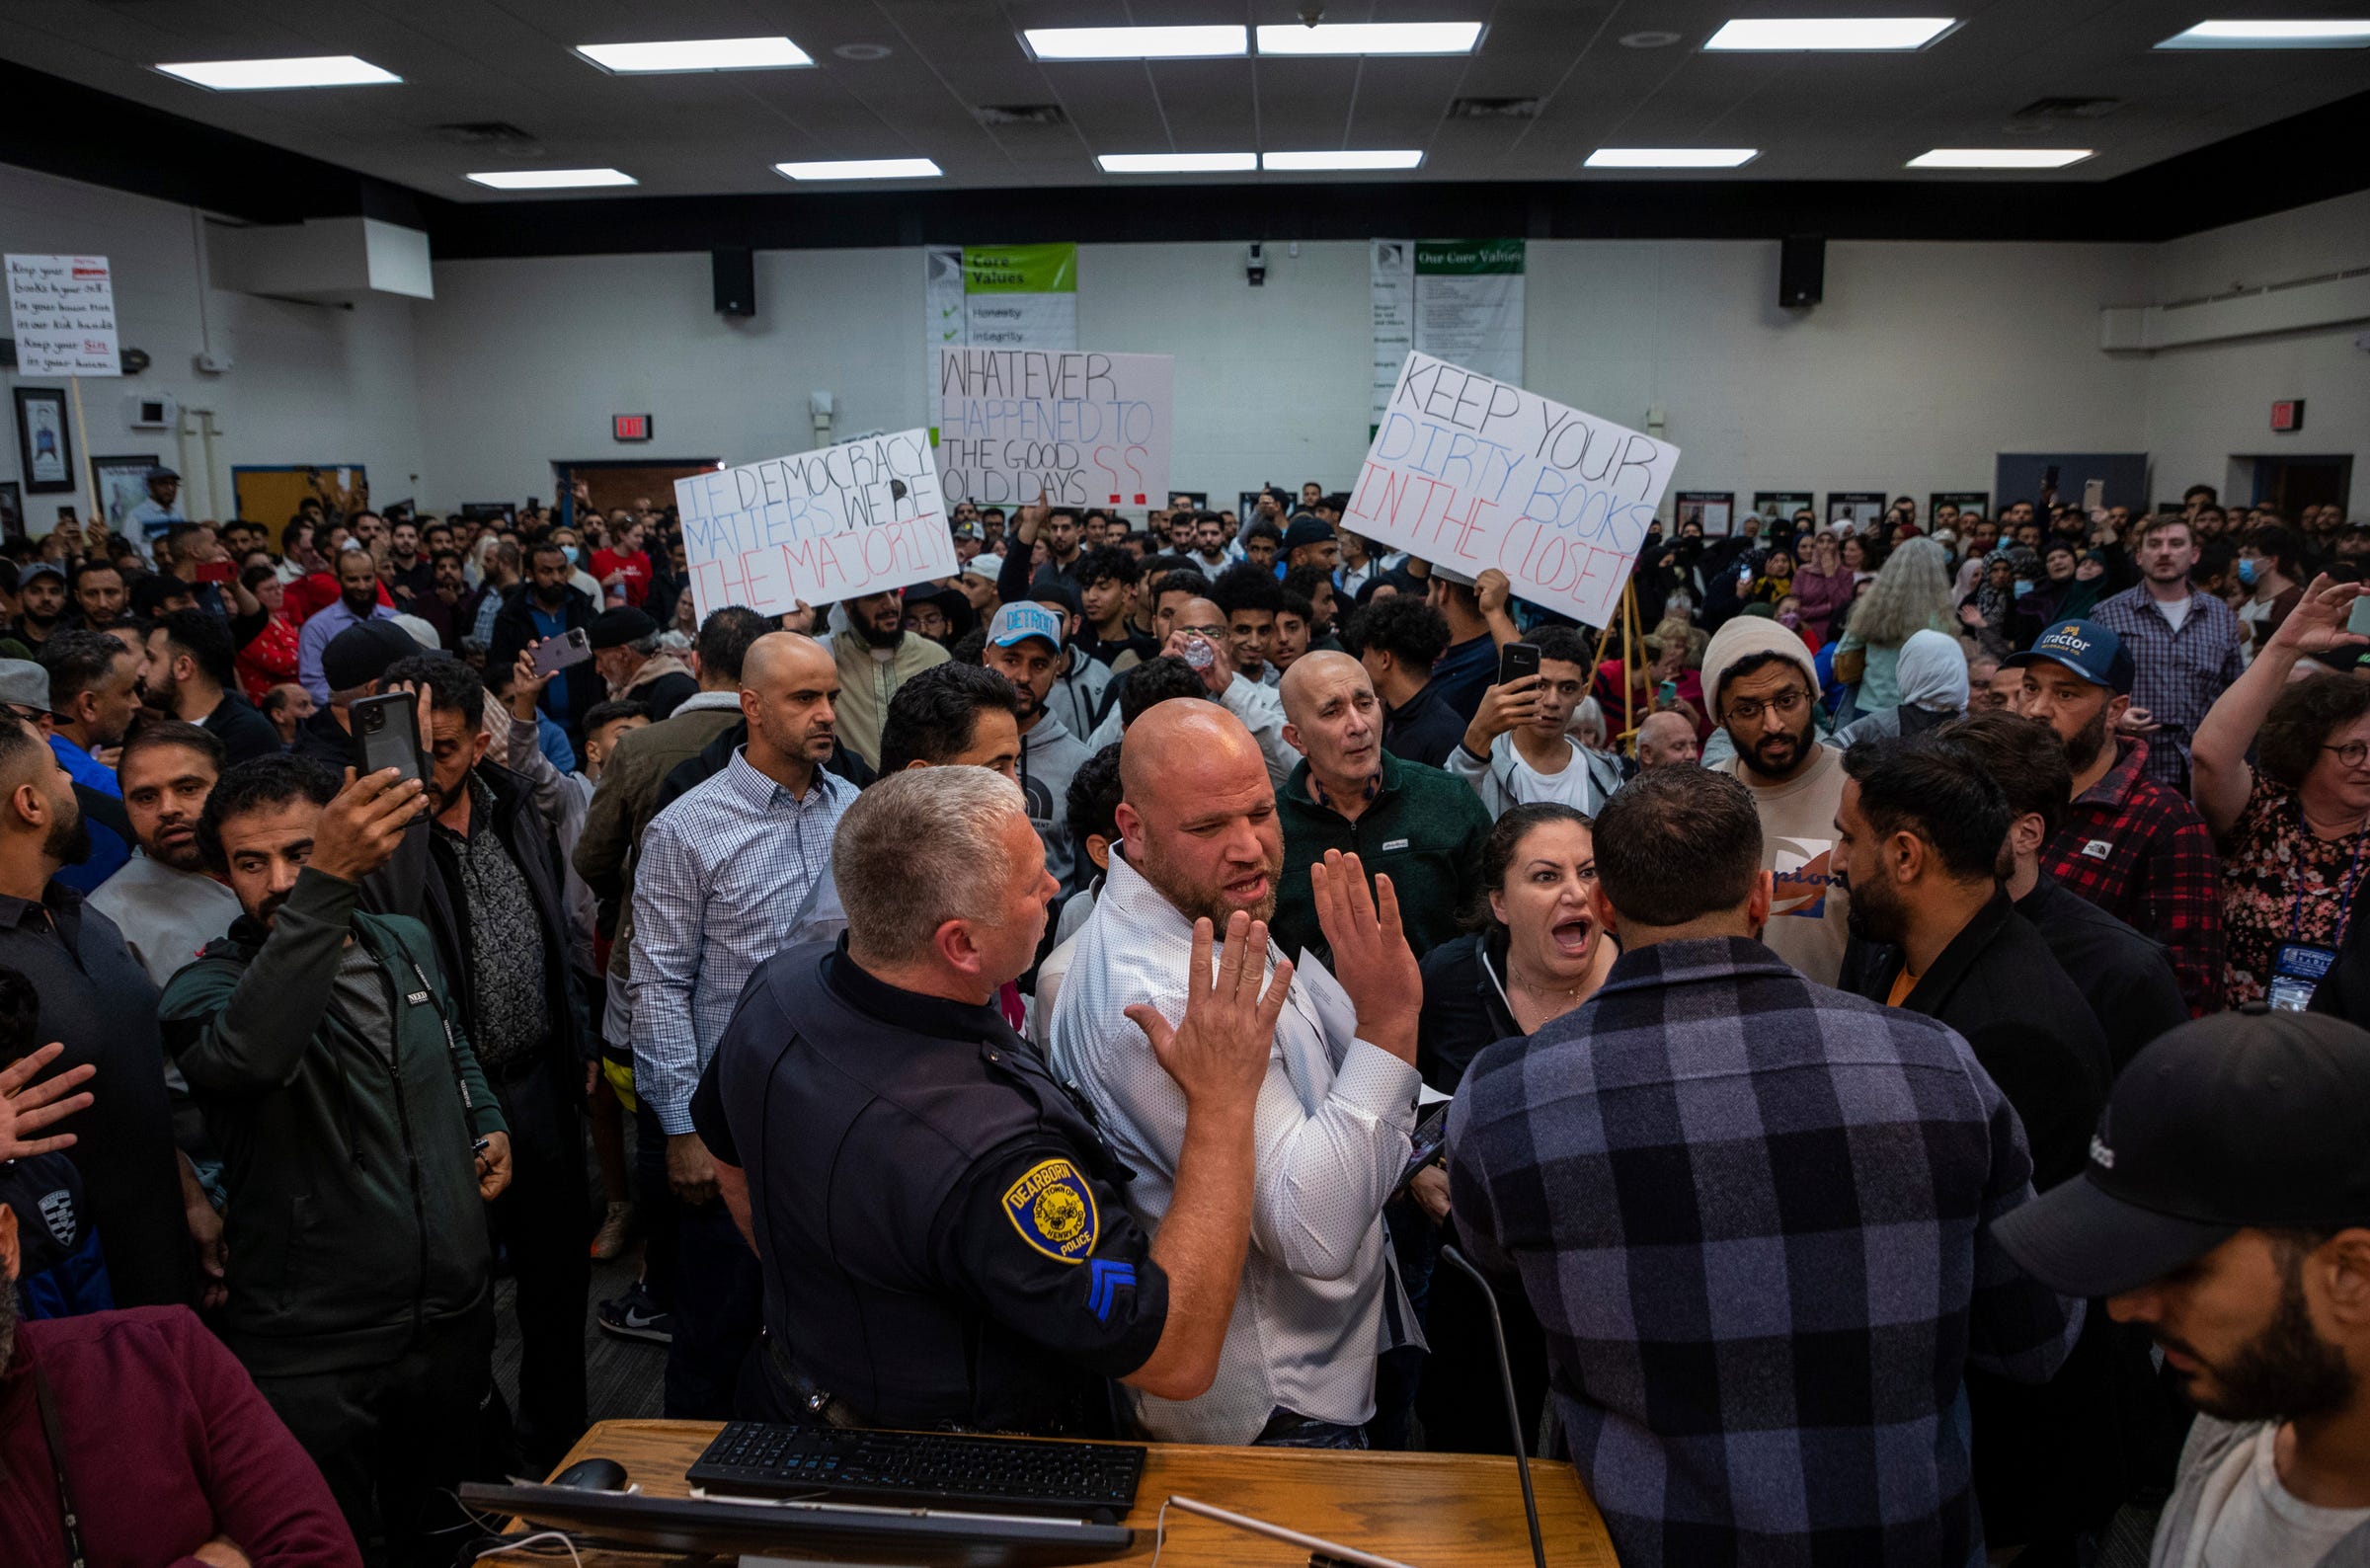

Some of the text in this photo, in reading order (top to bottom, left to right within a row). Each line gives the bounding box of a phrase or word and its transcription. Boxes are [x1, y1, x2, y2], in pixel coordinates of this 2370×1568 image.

[973, 255, 1009, 267] Core
[1418, 252, 1444, 264] Our
[1447, 251, 1476, 264] Core
[973, 273, 1024, 284] Values
[973, 308, 1023, 320] Honesty
[973, 331, 1024, 343] Integrity
[941, 349, 1117, 400] WHATEVER
[617, 416, 642, 437] EXIT
[941, 399, 1153, 445] HAPPENED TO
[1397, 356, 1658, 502] KEEP YOUR
[941, 438, 1079, 471] THE GOOD
[678, 431, 933, 522] IF DEMOCRACY
[942, 467, 1087, 505] OLD DAYS
[1377, 413, 1656, 557] DIRTY BOOKS
[684, 493, 835, 564] MATTERS
[1346, 461, 1637, 612] IN THE CLOSET
[689, 515, 951, 614] THE MAJORITY
[1006, 608, 1054, 636] DETROIT
[1008, 1164, 1071, 1211] DEARBORN
[1035, 1186, 1075, 1219] HOME TOWN OF
[1047, 1210, 1084, 1239] HENRY FORD
[1060, 1230, 1092, 1257] POLICE
